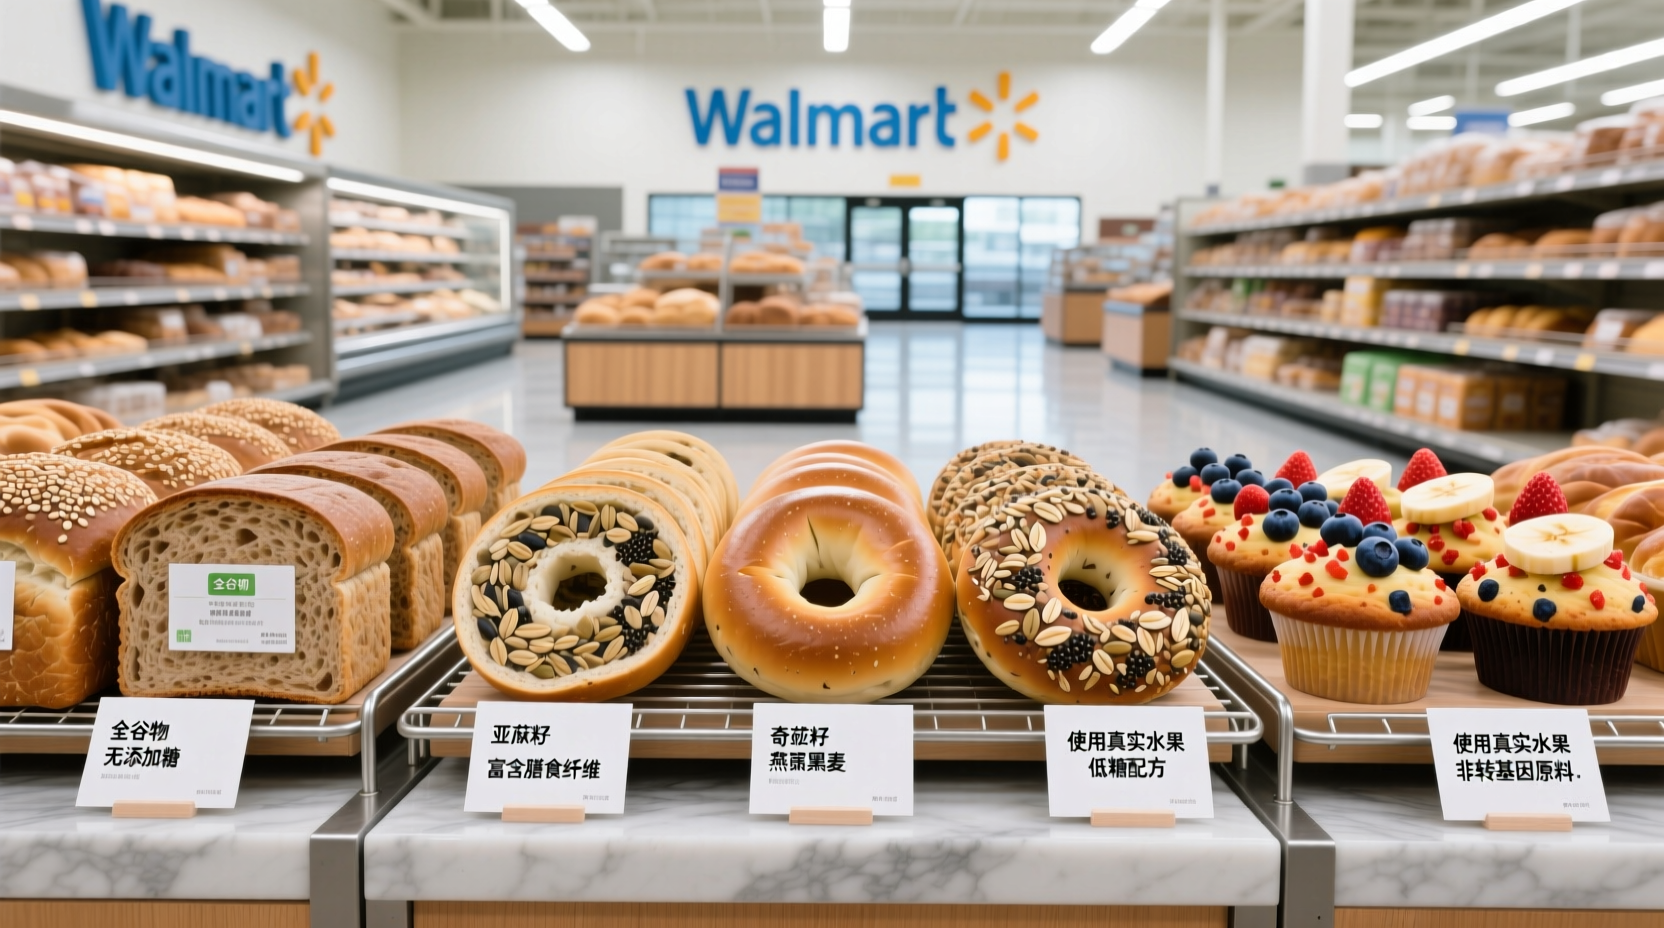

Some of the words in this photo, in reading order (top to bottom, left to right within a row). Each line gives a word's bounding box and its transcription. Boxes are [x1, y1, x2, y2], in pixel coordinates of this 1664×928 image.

[82, 0, 290, 136] Walmart
[686, 87, 956, 146] Walmart
[111, 720, 169, 741] 全谷物
[1068, 730, 1184, 751] 使用真实水果
[1453, 732, 1570, 754] 使用真实水果
[104, 747, 180, 768] 无添加糖
[1089, 757, 1165, 778] 低糖配方
